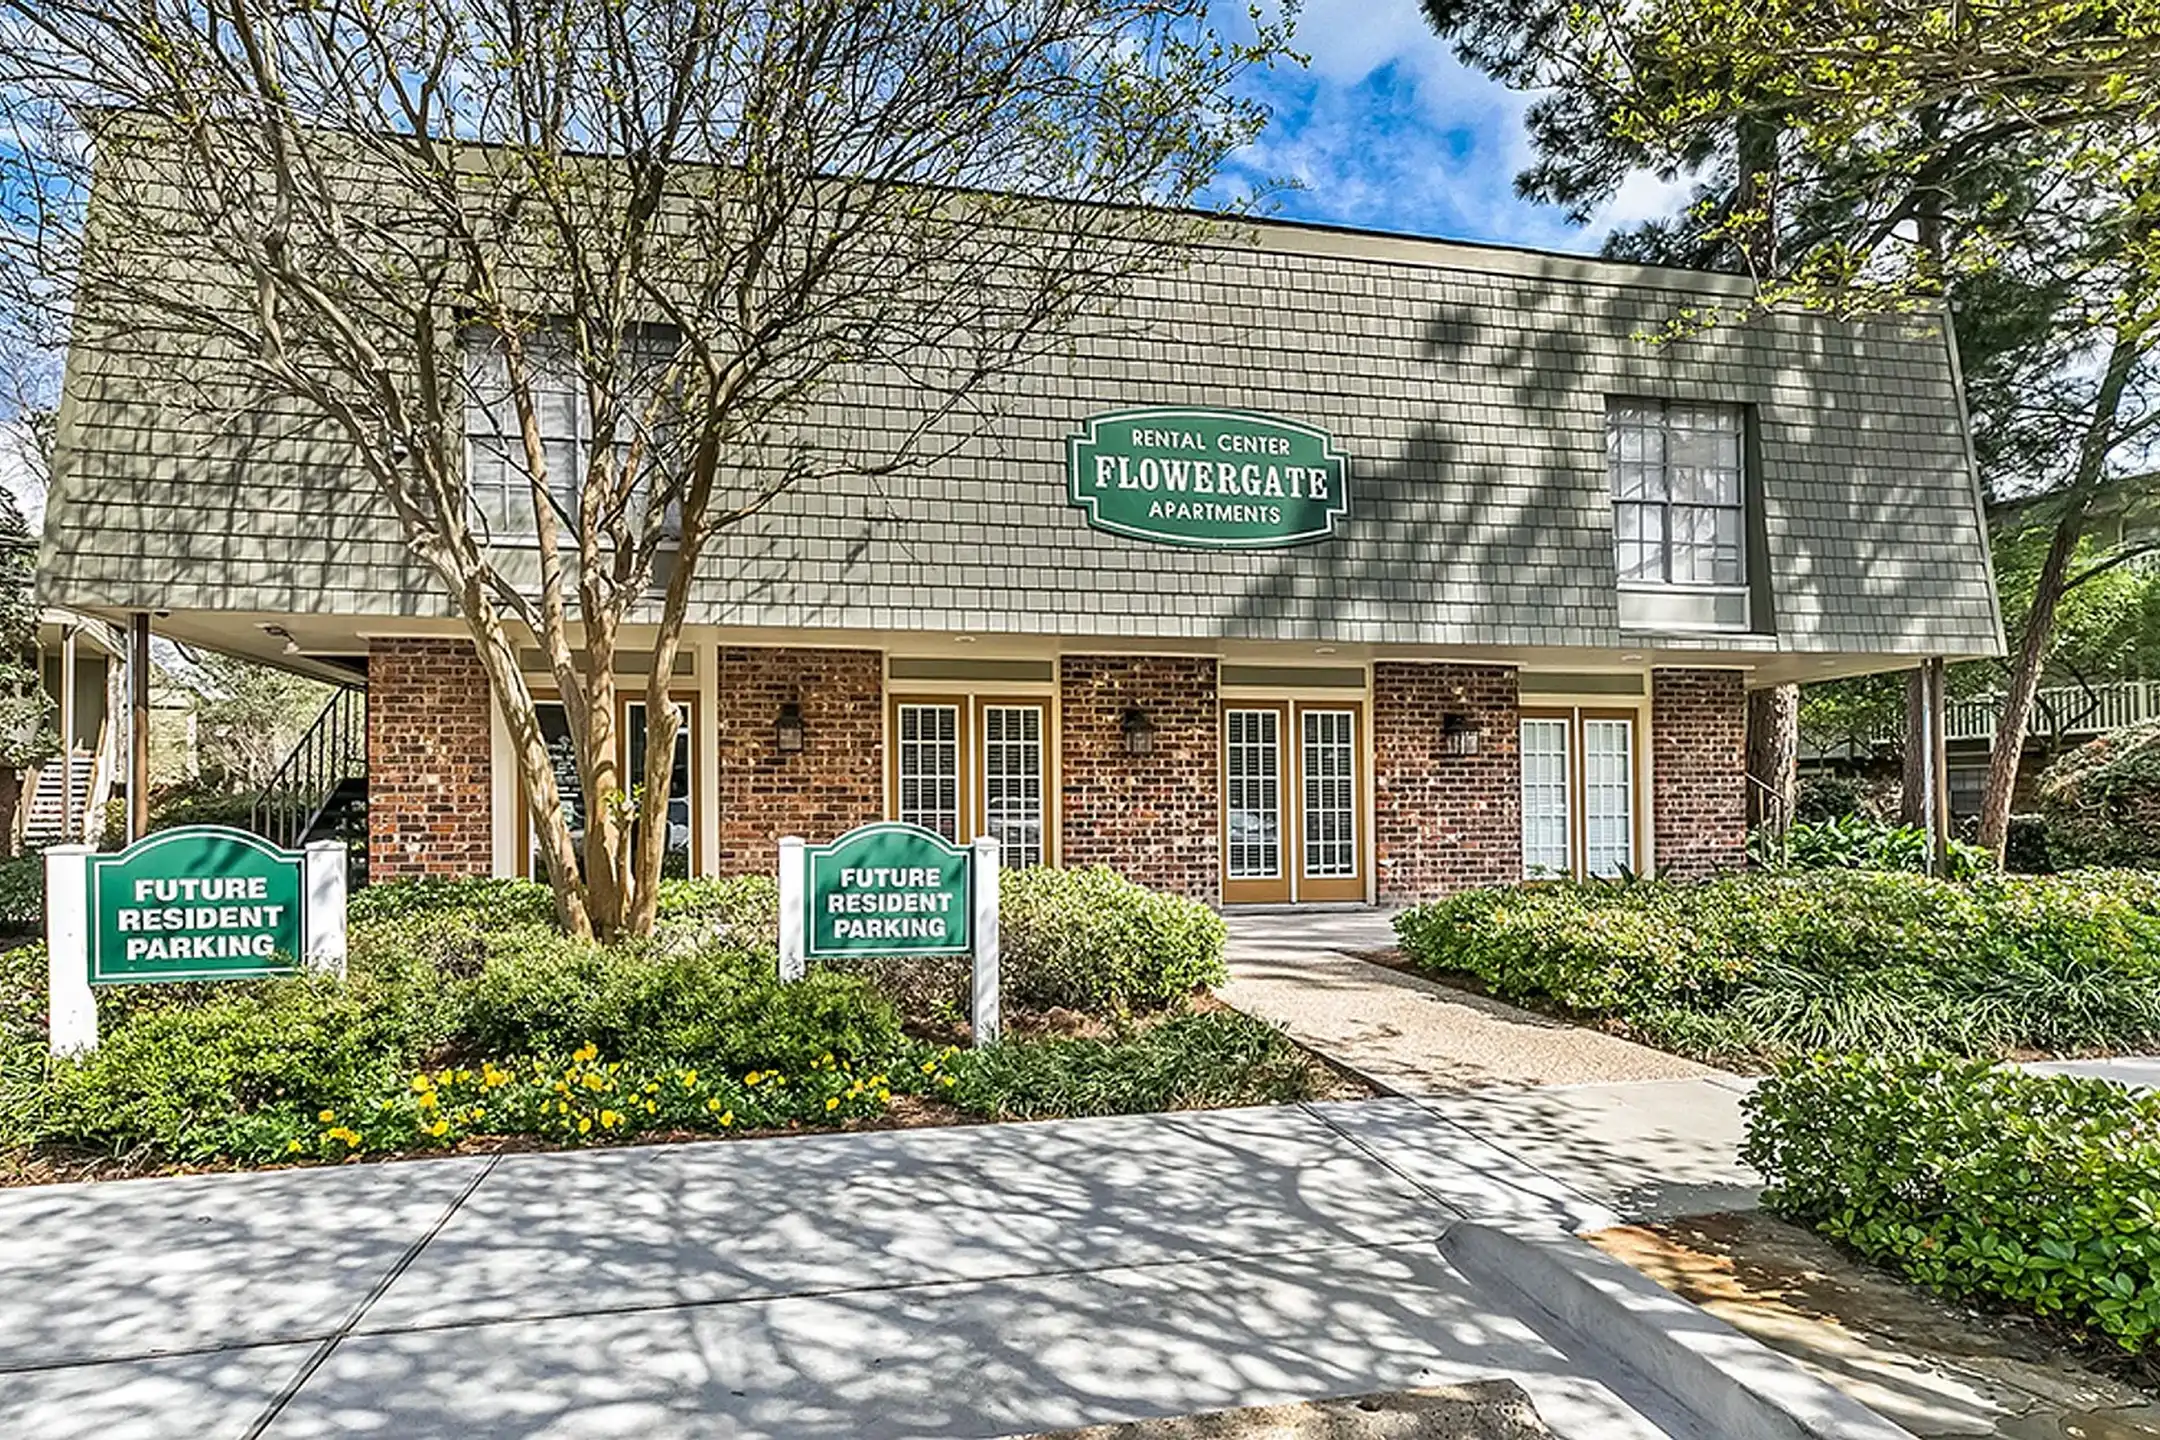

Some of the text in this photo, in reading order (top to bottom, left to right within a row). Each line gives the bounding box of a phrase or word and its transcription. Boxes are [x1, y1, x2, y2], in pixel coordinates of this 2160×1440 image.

[1132, 429, 1290, 456] RENTAL CENTER
[1094, 455, 1328, 500] FLOWERGATE
[1149, 501, 1281, 523] APARTMENTS
[134, 877, 267, 901] FUTURE
[841, 868, 941, 887] FUTURE
[828, 893, 952, 913] RESIDENT
[117, 906, 283, 931] RESIDENT
[834, 918, 946, 938] PARKING
[126, 934, 275, 960] PARKING
